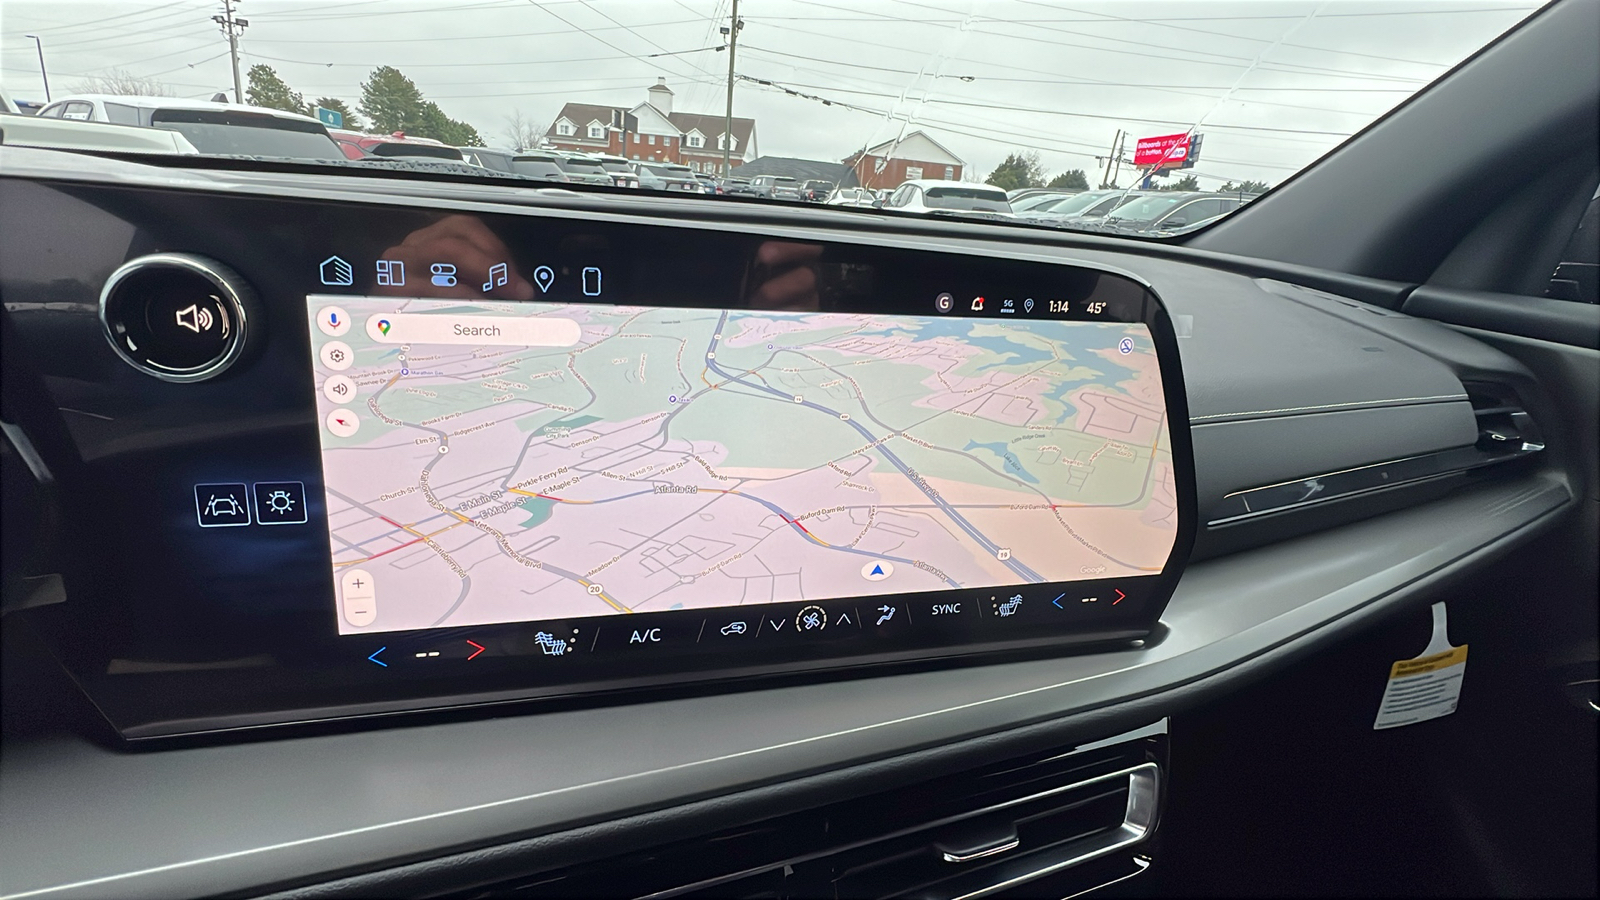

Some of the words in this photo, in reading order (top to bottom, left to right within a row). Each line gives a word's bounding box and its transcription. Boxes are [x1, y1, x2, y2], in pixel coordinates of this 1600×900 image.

[1138, 140, 1161, 149] Billboards
[940, 297, 949, 308] G
[1003, 299, 1014, 308] 5G
[1049, 300, 1070, 314] 1:14
[1086, 301, 1107, 314] 45°
[453, 323, 502, 337] Search
[355, 379, 379, 387] Sawnee
[393, 419, 403, 427] St
[421, 417, 440, 427] Brooks
[641, 414, 659, 425] Denson
[453, 425, 485, 437] Ridgecrest
[484, 421, 496, 430] Ave
[415, 438, 429, 446] Elm
[428, 436, 437, 444] St
[570, 438, 591, 449] Denson
[591, 435, 600, 443] Dr
[1003, 452, 1013, 463] Lake
[636, 468, 647, 476] Hill
[665, 465, 676, 474] Hill
[694, 455, 707, 468] Bald
[704, 464, 719, 480] Ridge
[718, 474, 728, 482] Rd
[828, 461, 844, 476] Oxford
[842, 469, 853, 478] Rd
[517, 476, 539, 490] Pirkle
[539, 469, 558, 483] Ferry
[557, 466, 568, 475] Rd
[601, 470, 618, 480] Allen
[618, 474, 627, 482] St
[420, 469, 439, 510] Dahlonega
[436, 503, 446, 513] St
[549, 479, 572, 494] Maple
[572, 476, 581, 485] St
[654, 485, 685, 495] Atlanta
[686, 485, 698, 494] Rd
[842, 481, 868, 491] Shamrock
[380, 489, 406, 502] Church
[406, 486, 416, 495] St
[459, 502, 467, 512] E
[466, 494, 490, 510] Main
[490, 490, 503, 501] St
[480, 509, 488, 519] E
[487, 500, 515, 518] Maple
[515, 496, 528, 508] St
[800, 510, 821, 521] Buford
[821, 507, 836, 516] Dam
[836, 505, 846, 513] Rd
[474, 520, 502, 542] Veterans
[501, 539, 526, 567] Memorial
[525, 558, 542, 570] Blvd
[427, 539, 459, 573] Castleberry
[457, 566, 467, 579] Rd
[588, 560, 613, 577] Meadow
[612, 555, 621, 564] Dr
[701, 564, 721, 577] Buford
[720, 558, 734, 568] Dam
[733, 552, 743, 560] Rd
[913, 559, 936, 575] Atlanta
[1080, 564, 1107, 575] Google
[931, 602, 961, 616] SYNC
[629, 628, 661, 644] A/C
